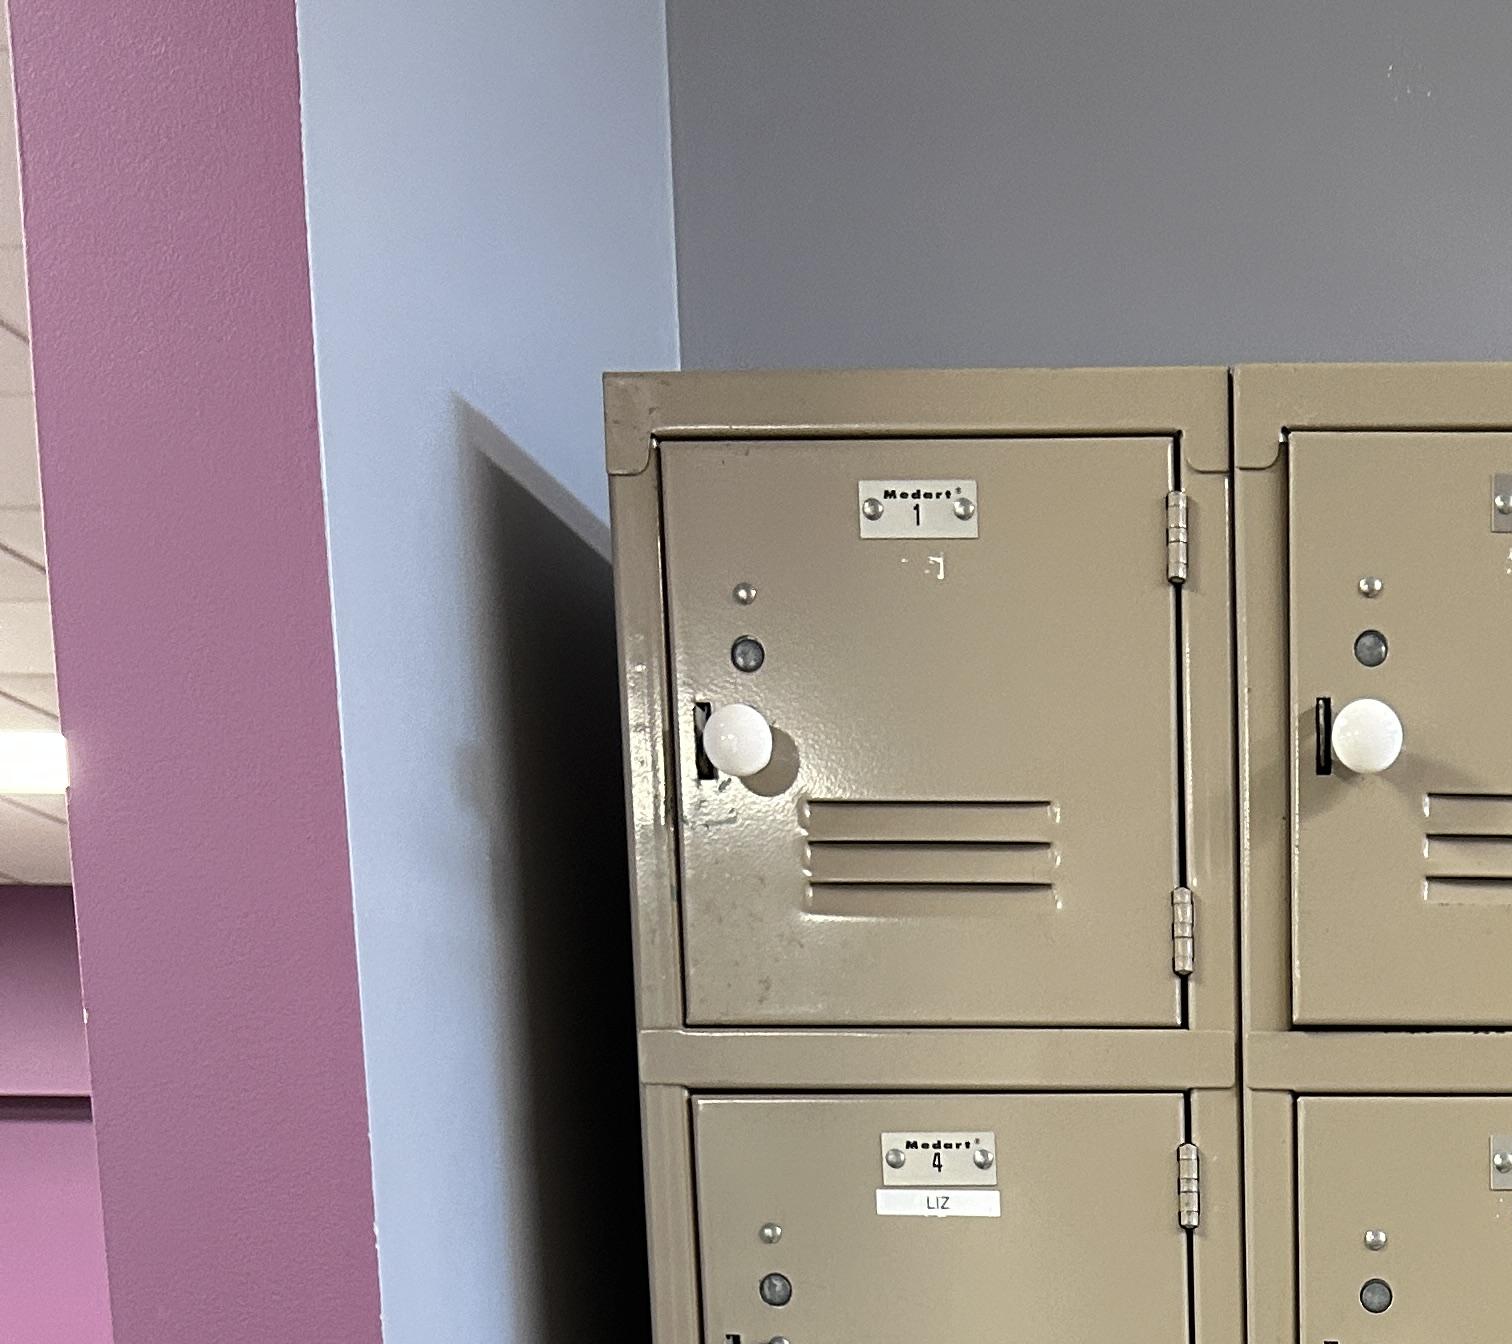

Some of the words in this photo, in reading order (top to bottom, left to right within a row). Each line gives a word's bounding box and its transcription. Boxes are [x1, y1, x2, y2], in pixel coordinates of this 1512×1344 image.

[914, 504, 919, 526] 1
[933, 1153, 942, 1172] 4
[926, 1196, 950, 1209] LIZ
